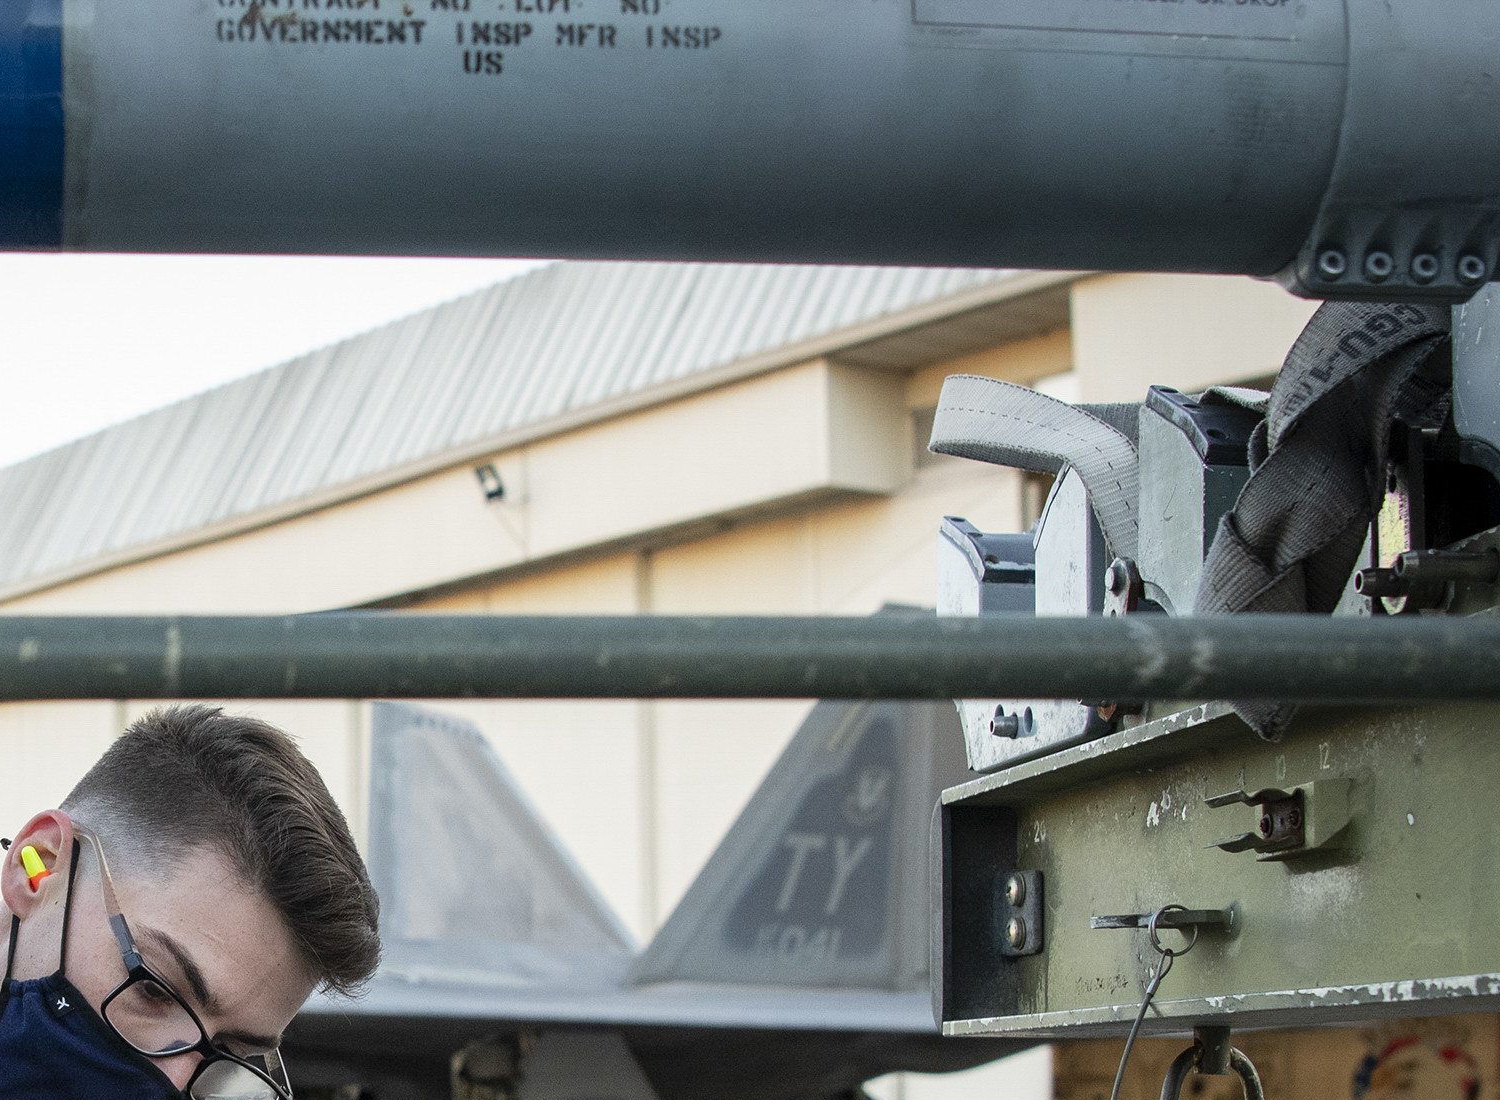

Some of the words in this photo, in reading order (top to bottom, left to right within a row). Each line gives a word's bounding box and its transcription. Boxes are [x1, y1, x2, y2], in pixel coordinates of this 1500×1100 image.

[217, 19, 426, 44] GOVERNMENT
[457, 21, 533, 46] INSP
[555, 23, 617, 48] MFR
[647, 25, 722, 49] INSP
[463, 50, 504, 75] US
[774, 832, 876, 915] TY
